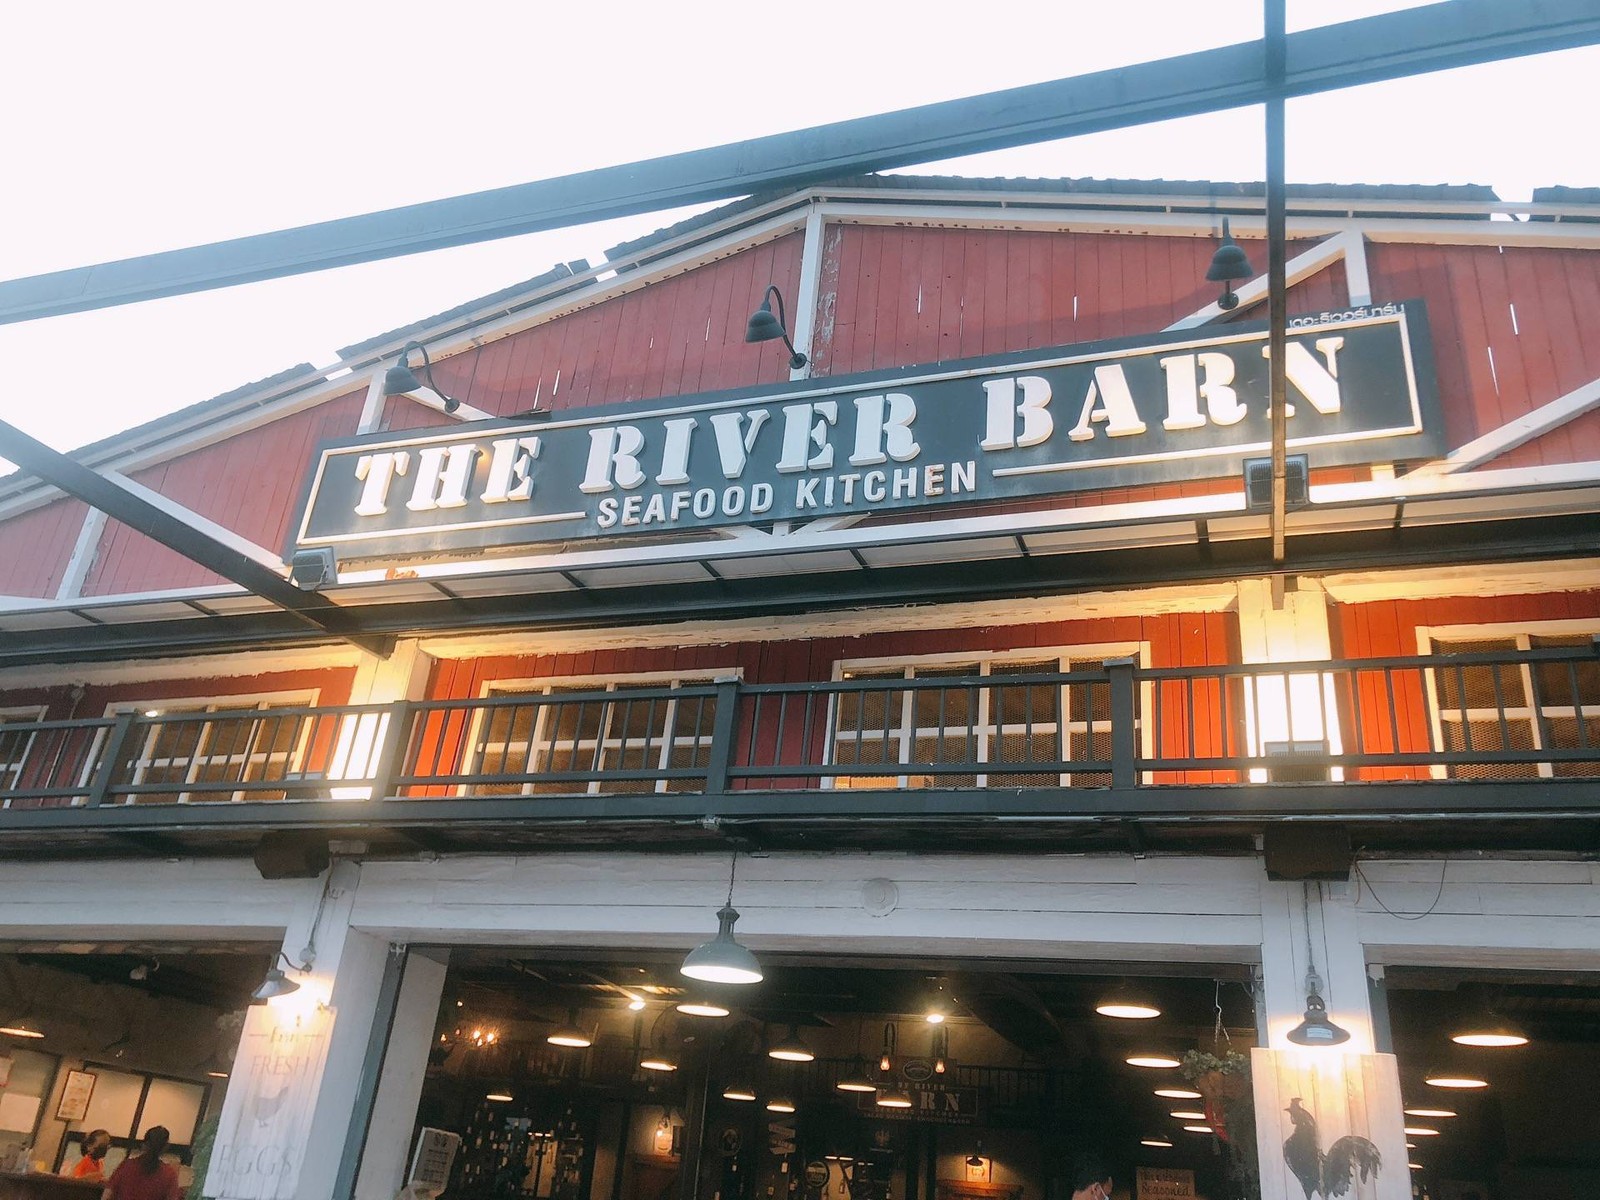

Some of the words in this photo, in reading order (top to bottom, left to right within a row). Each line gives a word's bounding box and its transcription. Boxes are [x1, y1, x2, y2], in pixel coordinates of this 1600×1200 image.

[354, 435, 542, 517] THE
[578, 391, 922, 494] RIVER
[980, 335, 1345, 452] BARN
[597, 482, 775, 529] SEAFOOD
[795, 458, 978, 509] KITCHEN
[250, 1055, 310, 1077] FRESH
[216, 1143, 296, 1177] EGGS
